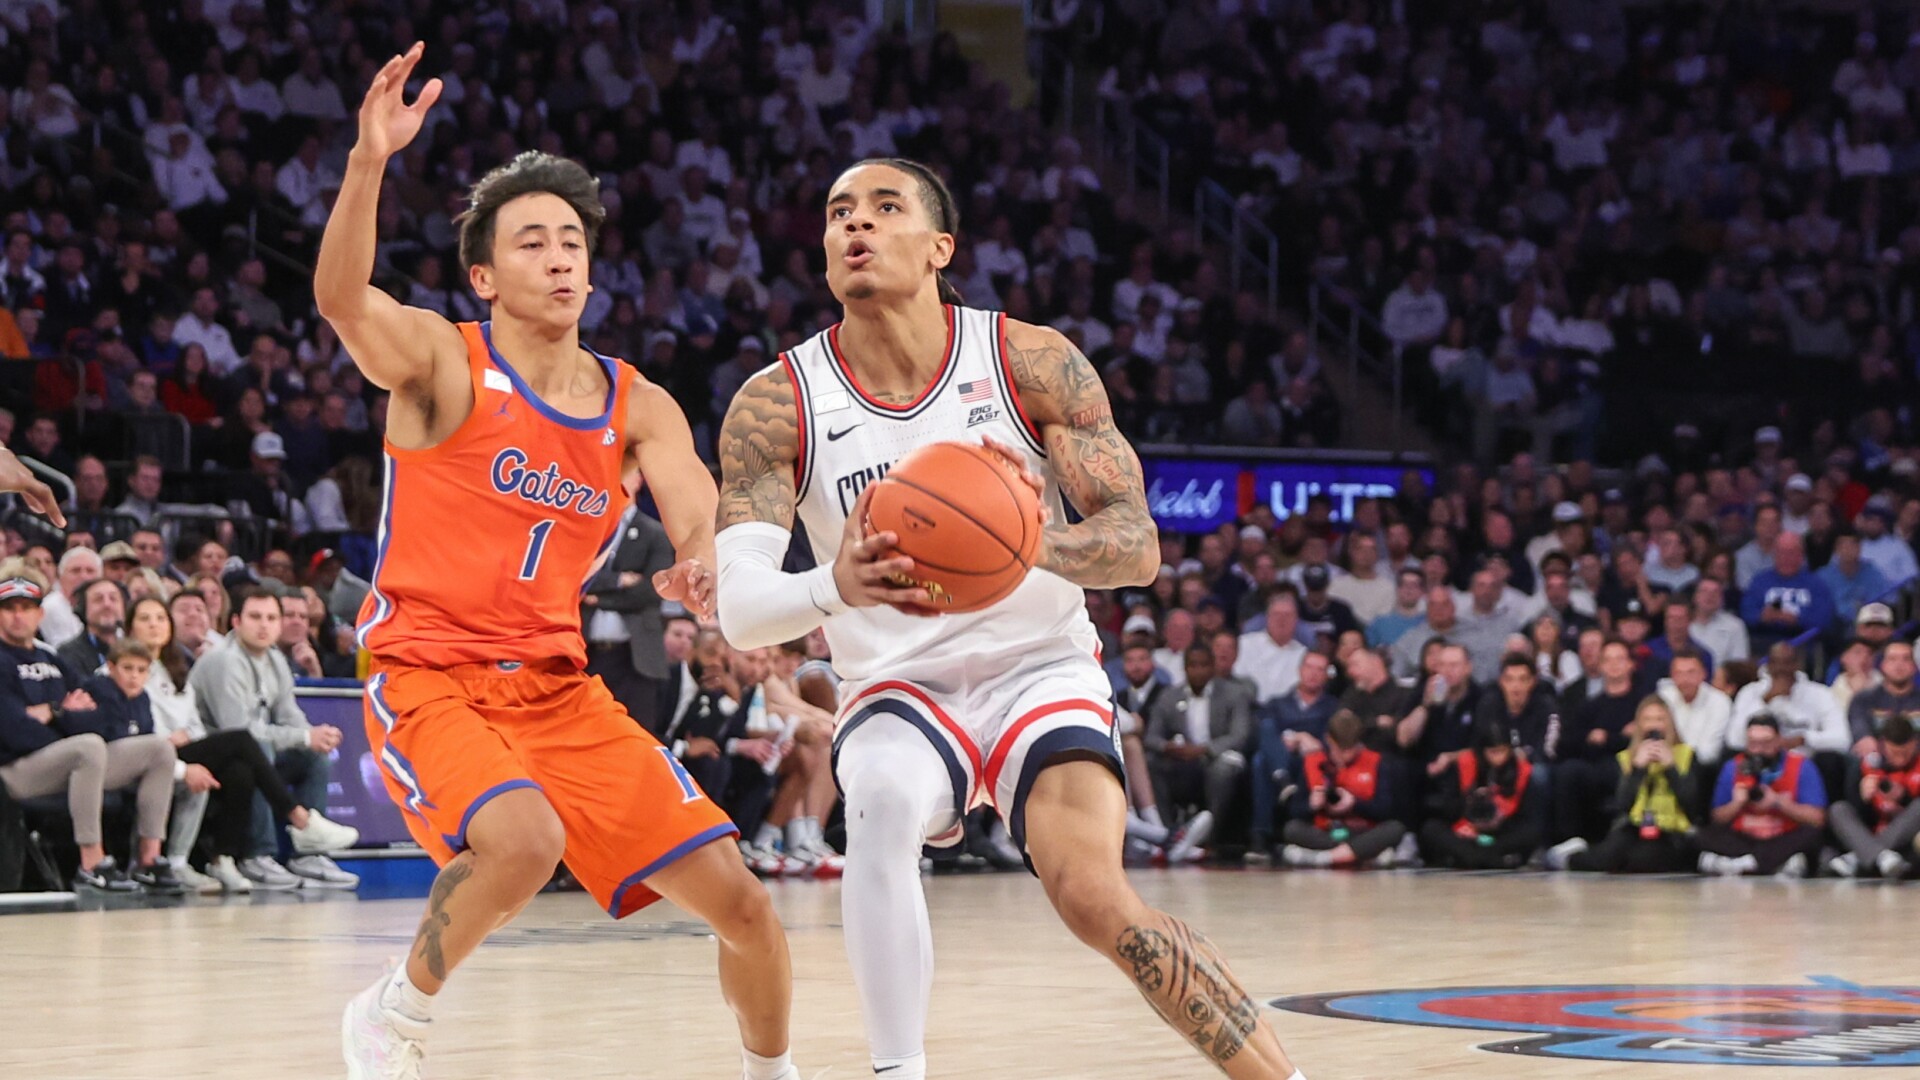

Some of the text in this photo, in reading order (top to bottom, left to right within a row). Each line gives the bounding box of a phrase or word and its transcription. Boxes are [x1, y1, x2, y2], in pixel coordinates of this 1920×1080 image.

[968, 410, 1000, 424] EAST
[970, 404, 992, 416] BIG
[491, 447, 609, 516] Gators
[518, 519, 556, 580] 1
